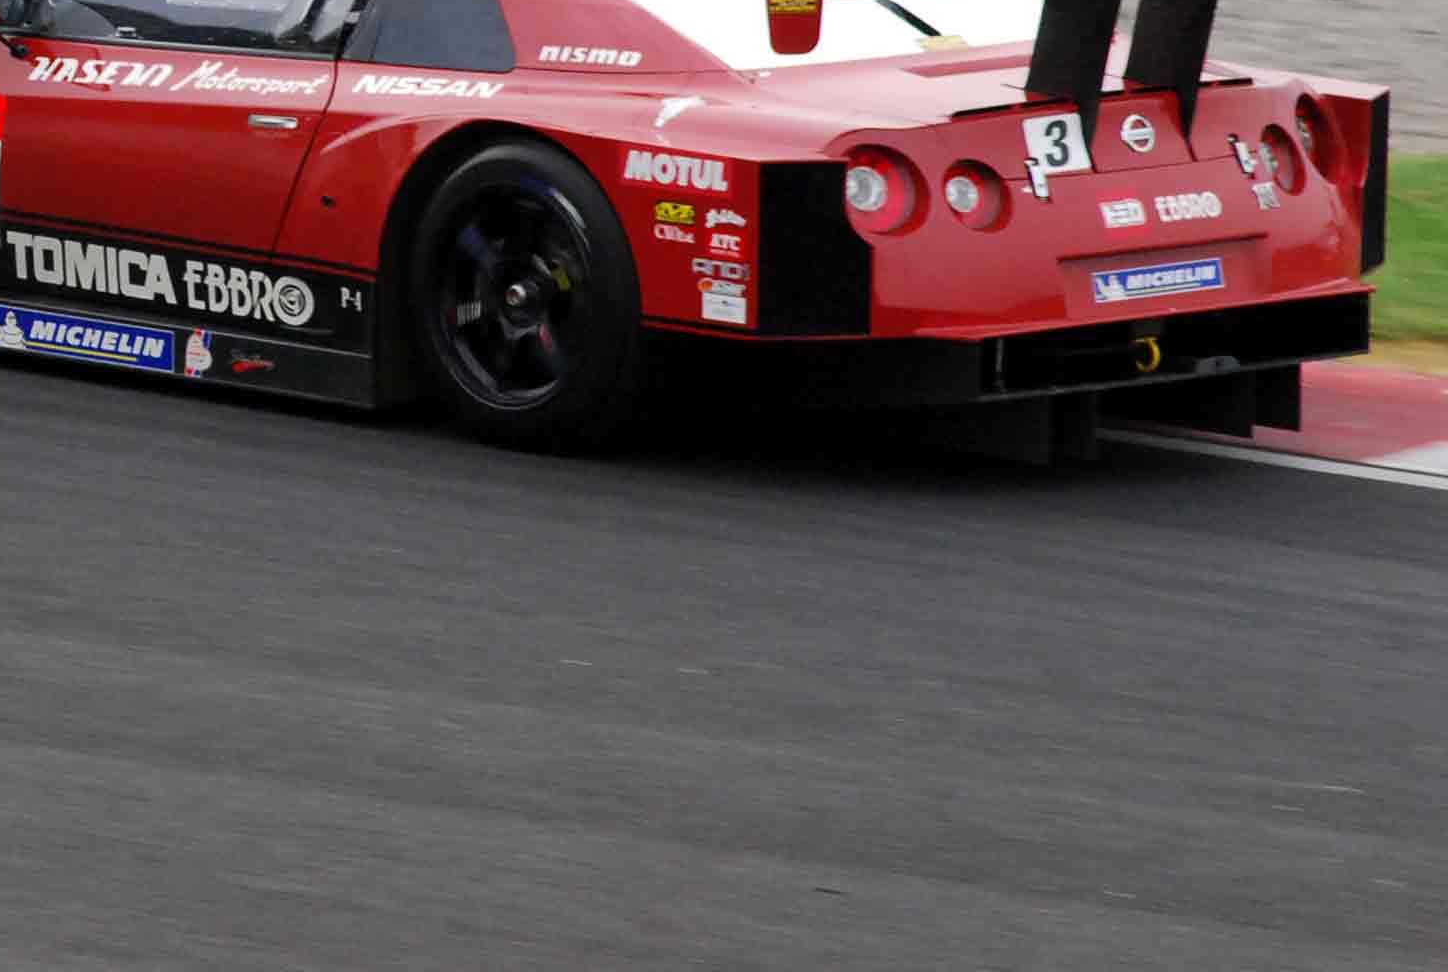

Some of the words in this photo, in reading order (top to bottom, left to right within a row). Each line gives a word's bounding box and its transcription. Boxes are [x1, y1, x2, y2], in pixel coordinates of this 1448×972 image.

[539, 44, 642, 68] nismo
[170, 59, 330, 95] Motorsport
[352, 74, 503, 99] NISSAN
[1044, 119, 1070, 167] 3
[624, 149, 729, 192] MOTUL
[6, 230, 177, 305] TOMICA
[183, 259, 315, 327] EBBRO
[1126, 265, 1217, 290] MICHELIN
[29, 320, 165, 358] MICHELIN
